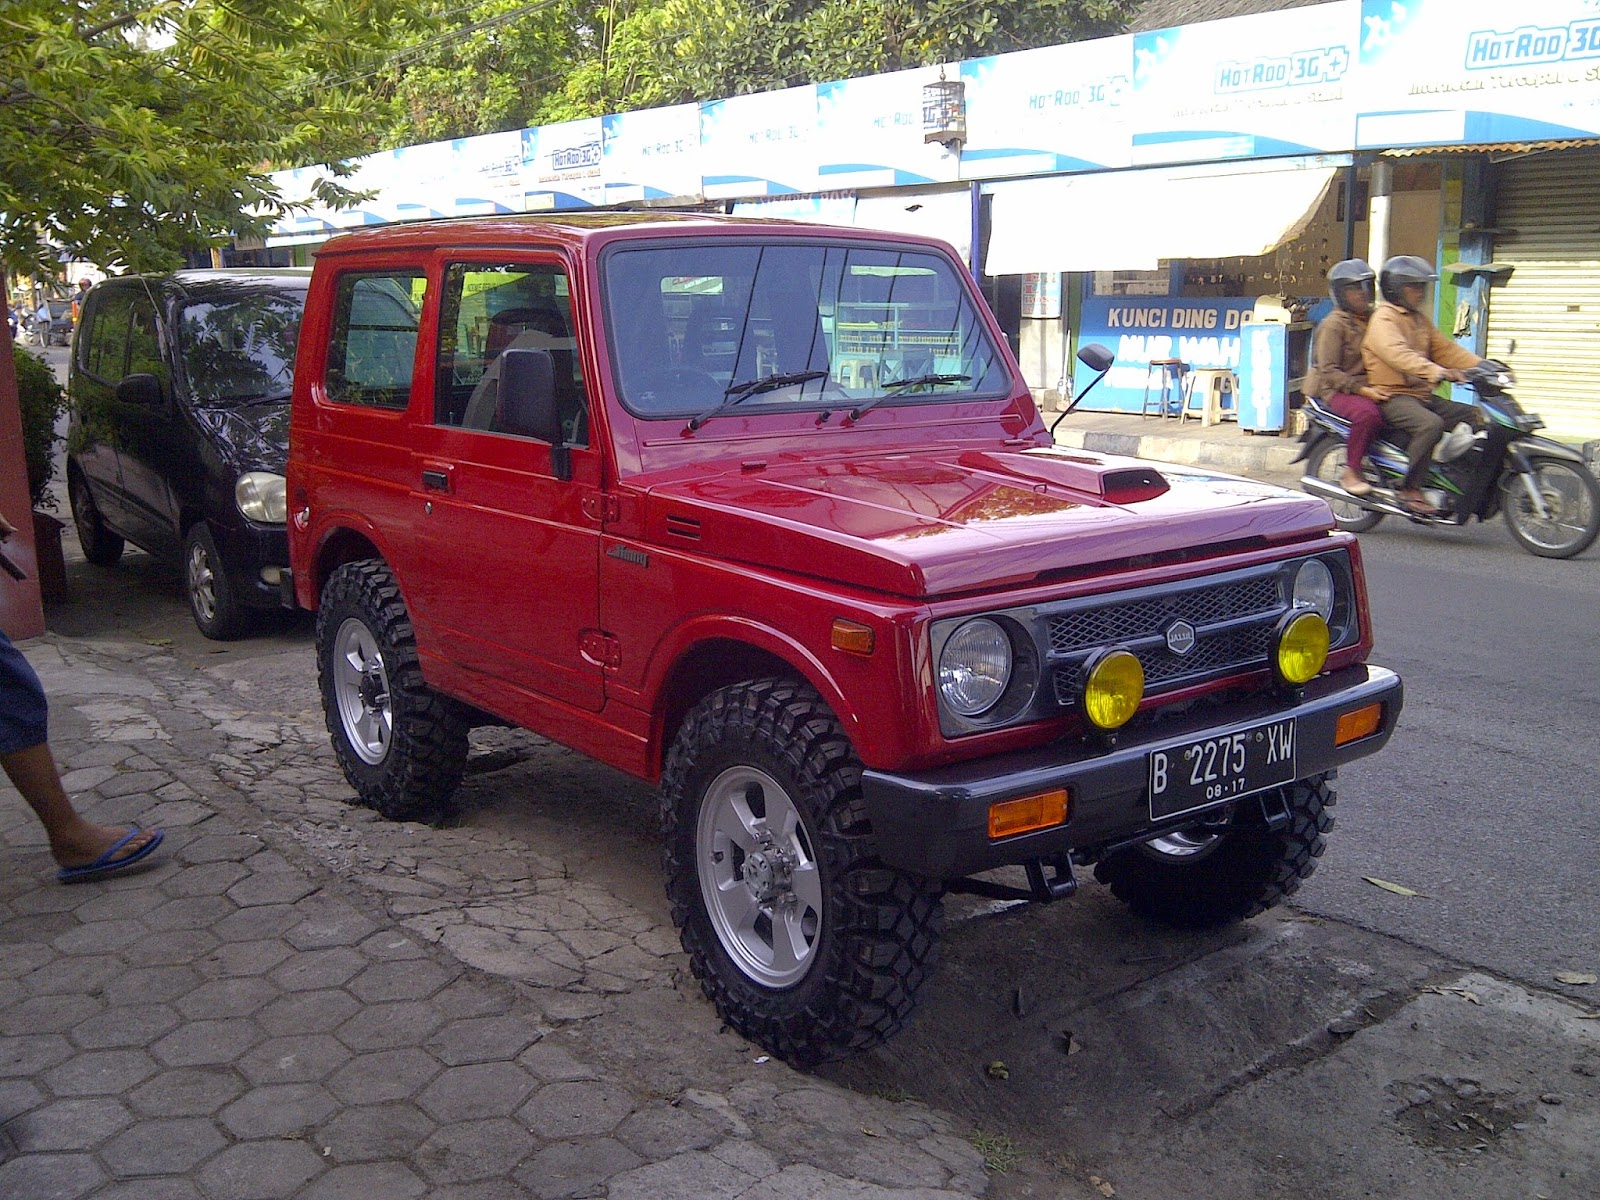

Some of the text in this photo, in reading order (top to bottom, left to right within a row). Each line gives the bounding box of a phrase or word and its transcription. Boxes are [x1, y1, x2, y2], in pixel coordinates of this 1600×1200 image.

[1107, 308, 1167, 327] KUNCI
[1171, 308, 1217, 329] DING
[1153, 721, 1294, 794] B 2275 XW
